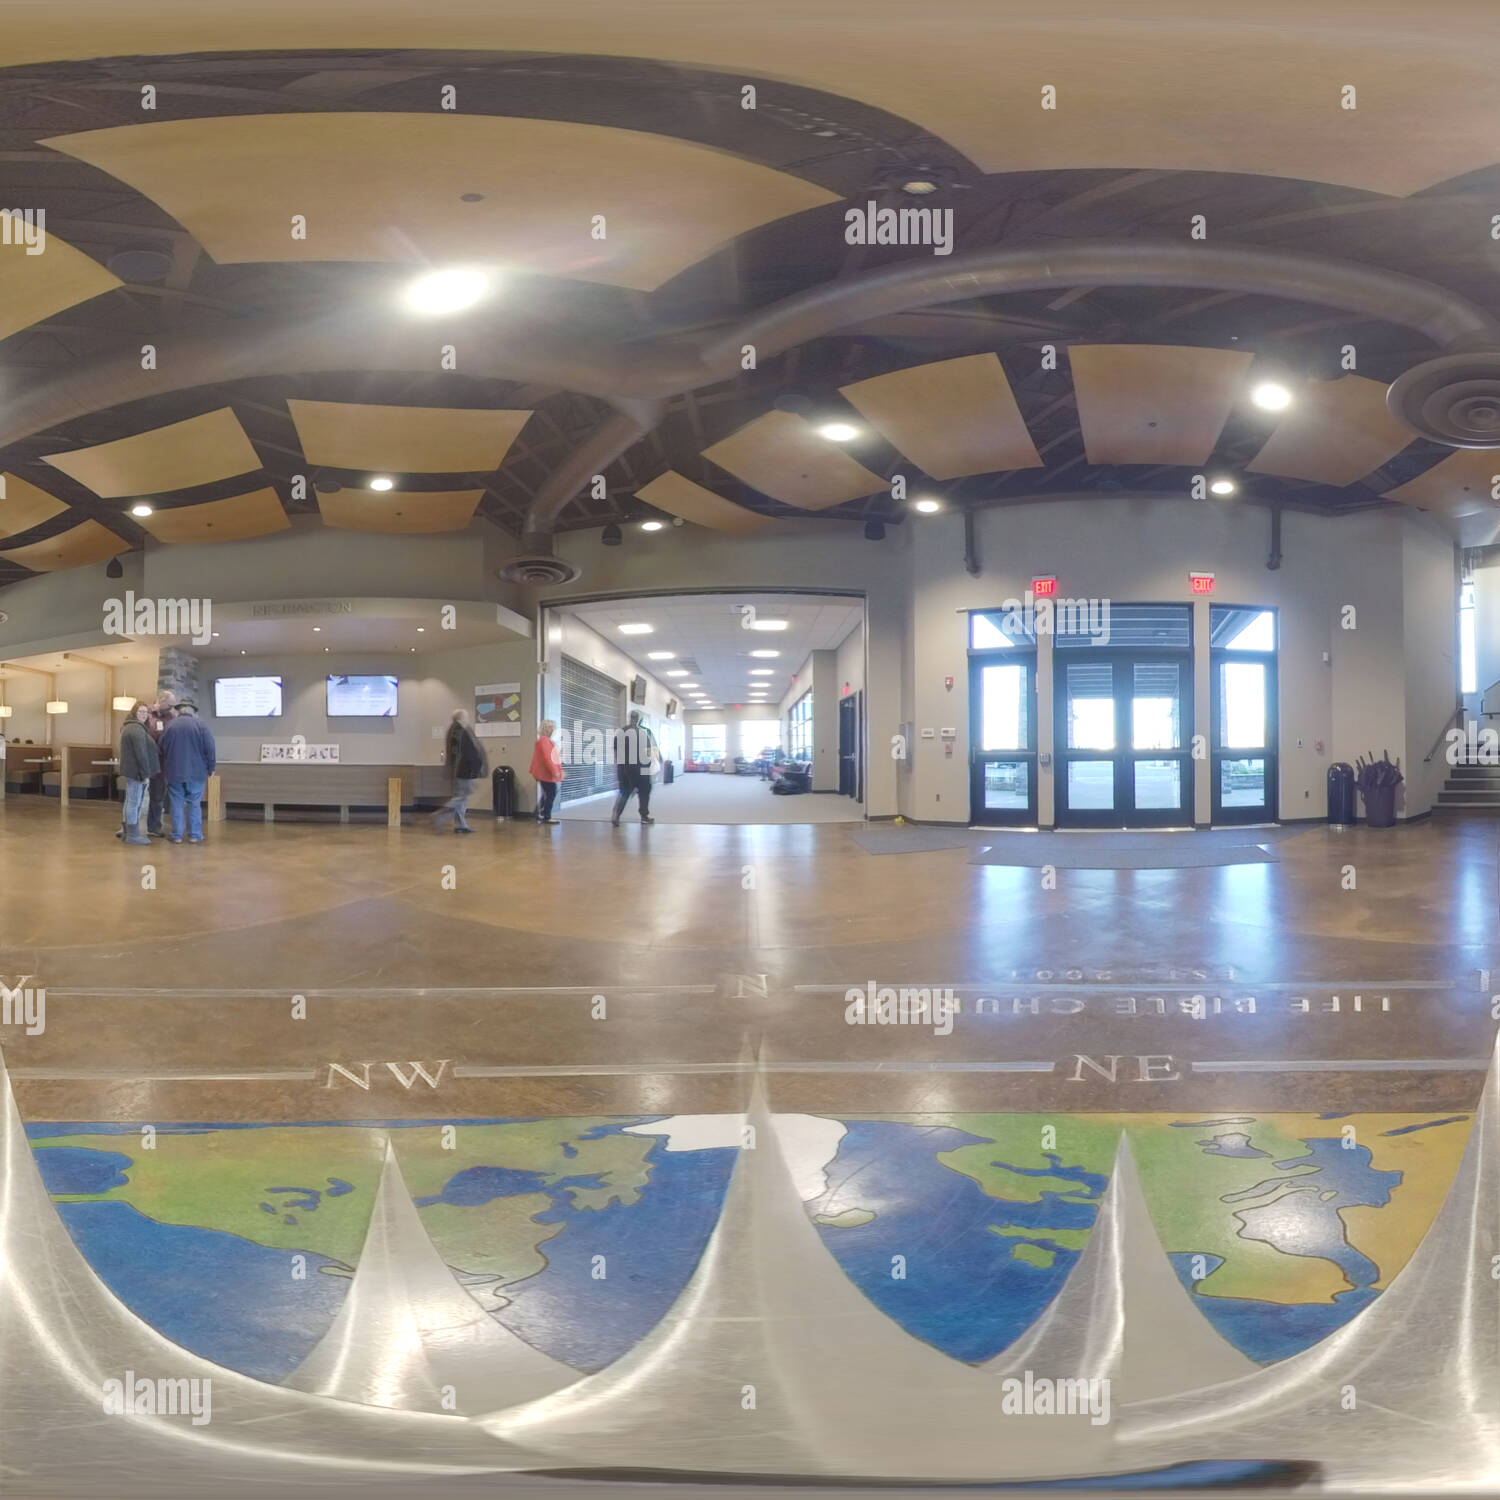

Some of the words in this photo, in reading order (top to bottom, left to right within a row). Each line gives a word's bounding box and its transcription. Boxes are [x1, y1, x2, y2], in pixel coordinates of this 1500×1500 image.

[1035, 581, 1052, 593] EXIT
[1194, 578, 1211, 591] EXIT
[727, 974, 768, 999] N
[1290, 995, 1391, 1013] LIFE
[318, 1059, 453, 1090] NW
[1065, 1054, 1181, 1083] NE
